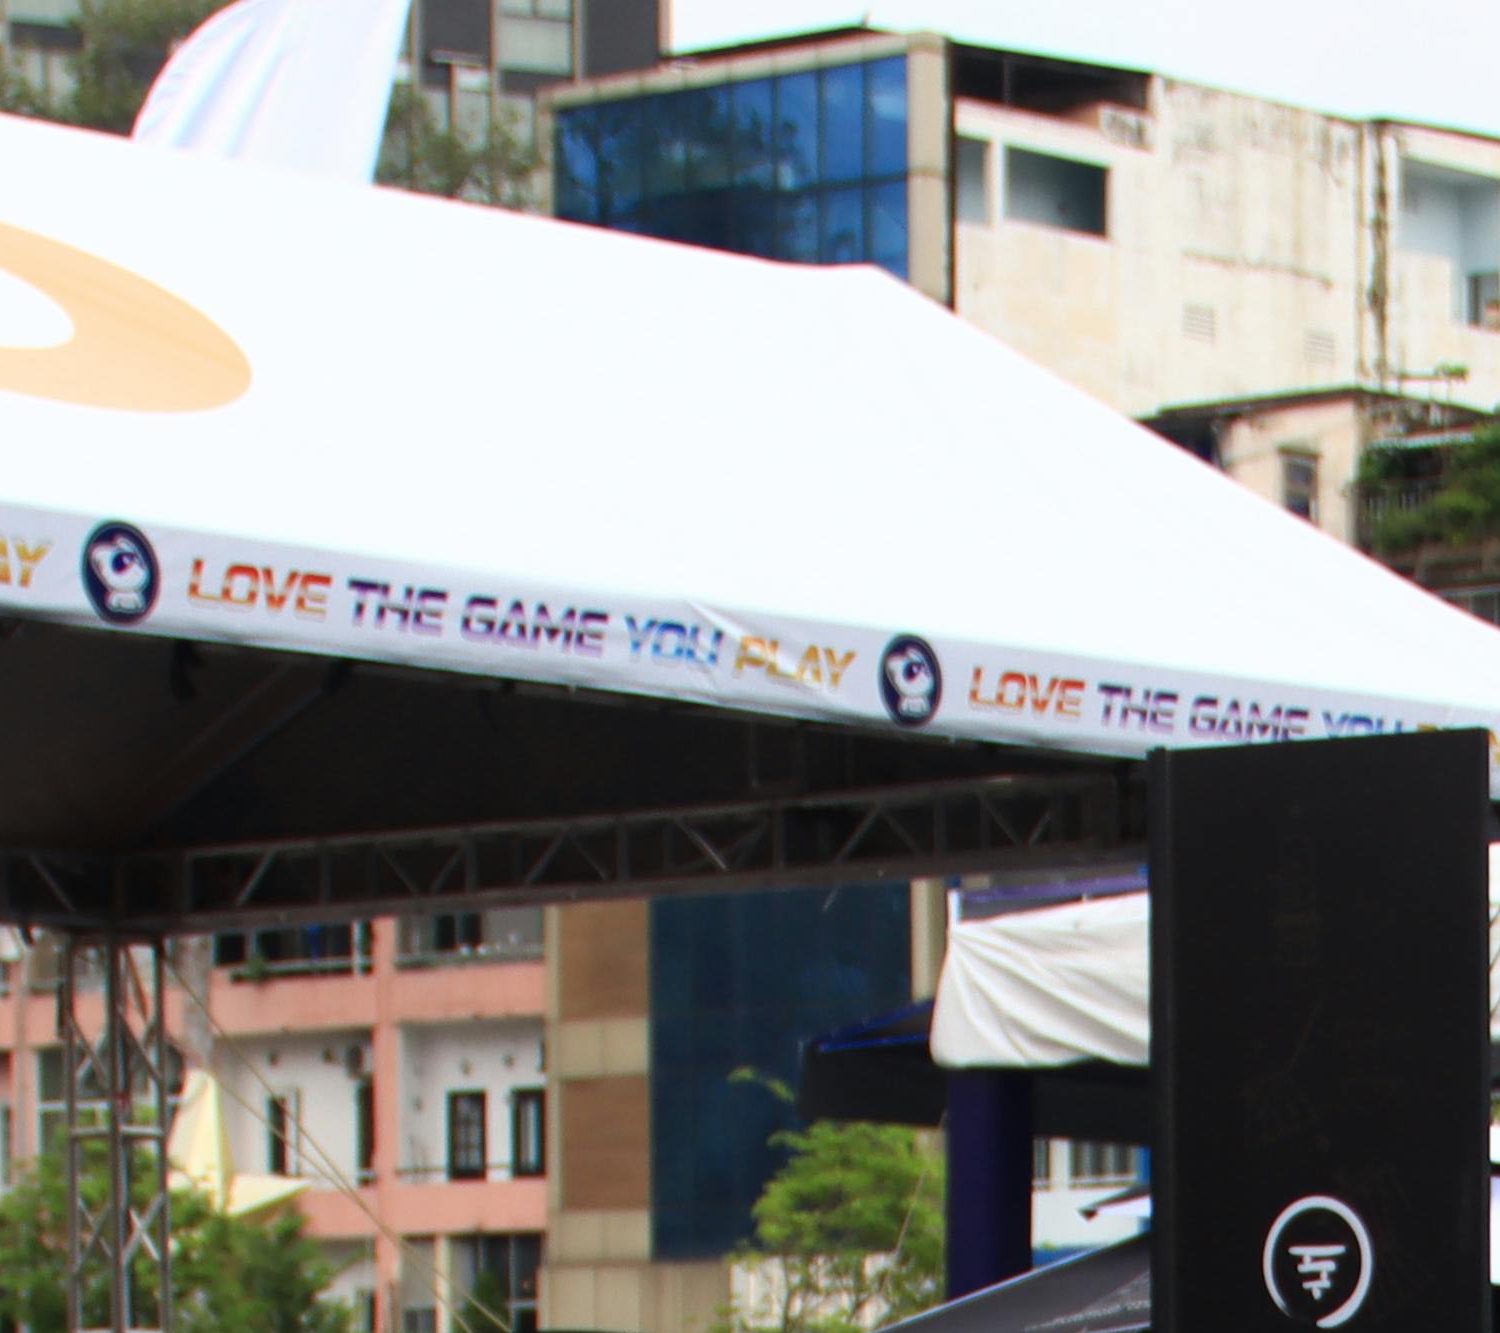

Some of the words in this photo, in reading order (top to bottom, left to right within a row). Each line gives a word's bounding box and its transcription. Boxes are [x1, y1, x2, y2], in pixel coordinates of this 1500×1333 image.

[186, 556, 334, 618] LOVE
[346, 576, 450, 636] THE
[459, 594, 610, 656] GAME
[622, 613, 721, 668] YOU
[732, 634, 859, 690] PLAY
[969, 665, 1086, 718] LOVE
[1098, 683, 1181, 730] THE
[1188, 696, 1311, 742] GAME
